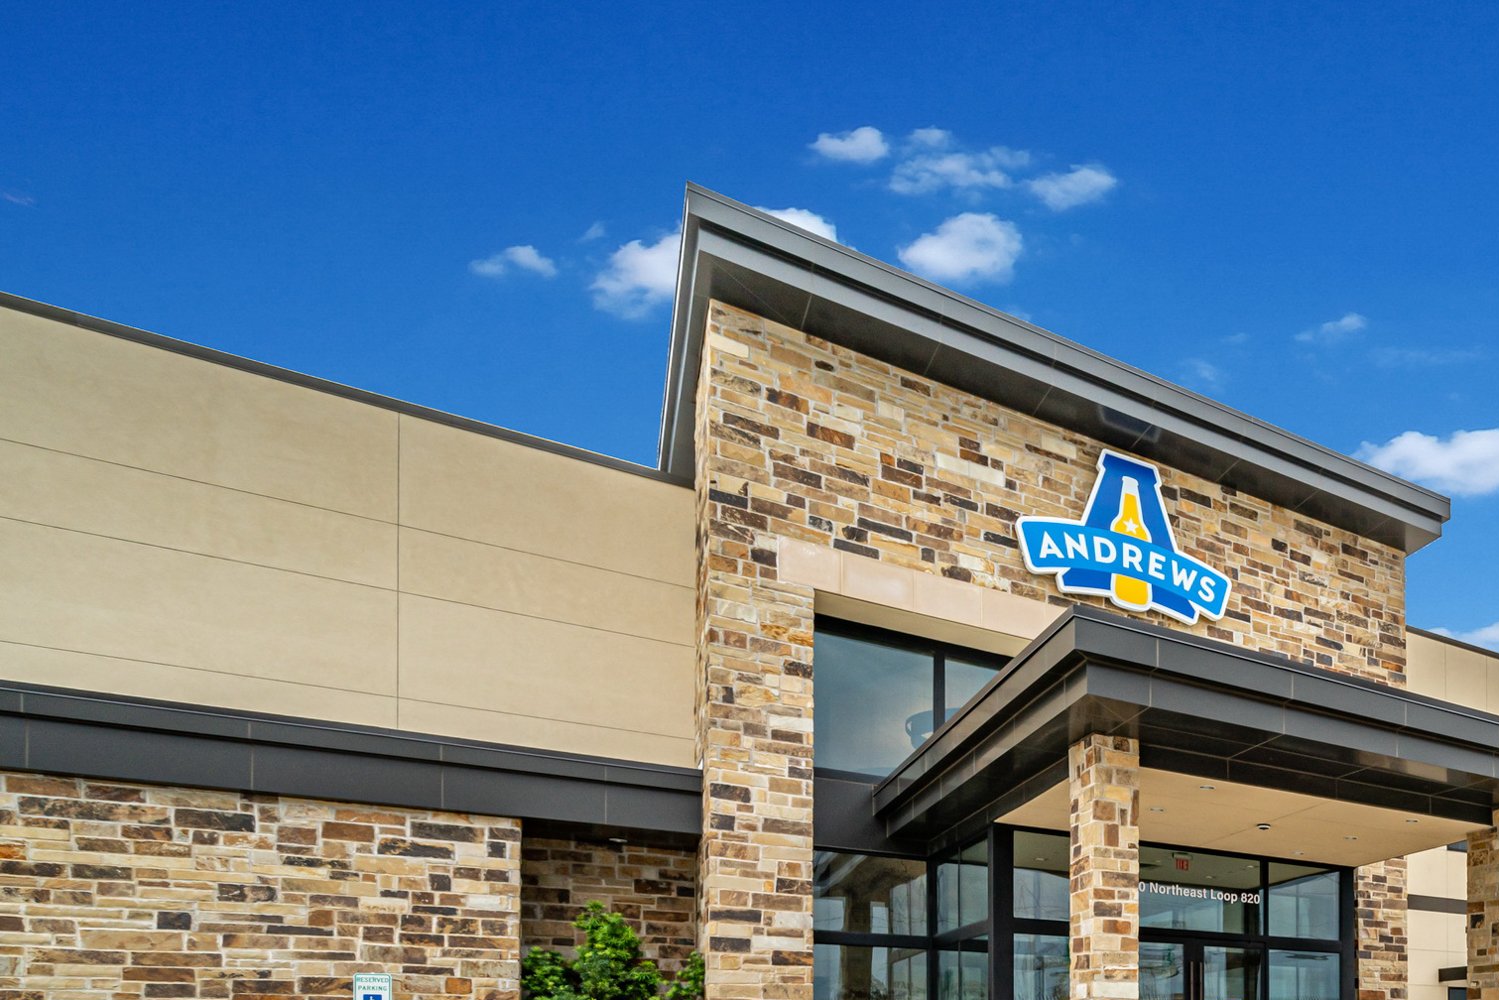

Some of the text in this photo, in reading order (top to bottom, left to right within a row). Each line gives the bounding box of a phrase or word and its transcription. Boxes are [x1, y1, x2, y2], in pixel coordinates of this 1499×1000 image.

[1039, 531, 1216, 602] ANDREWS
[1149, 882, 1207, 899] Northeast
[1210, 888, 1238, 904] Loop
[1240, 892, 1260, 905] 820
